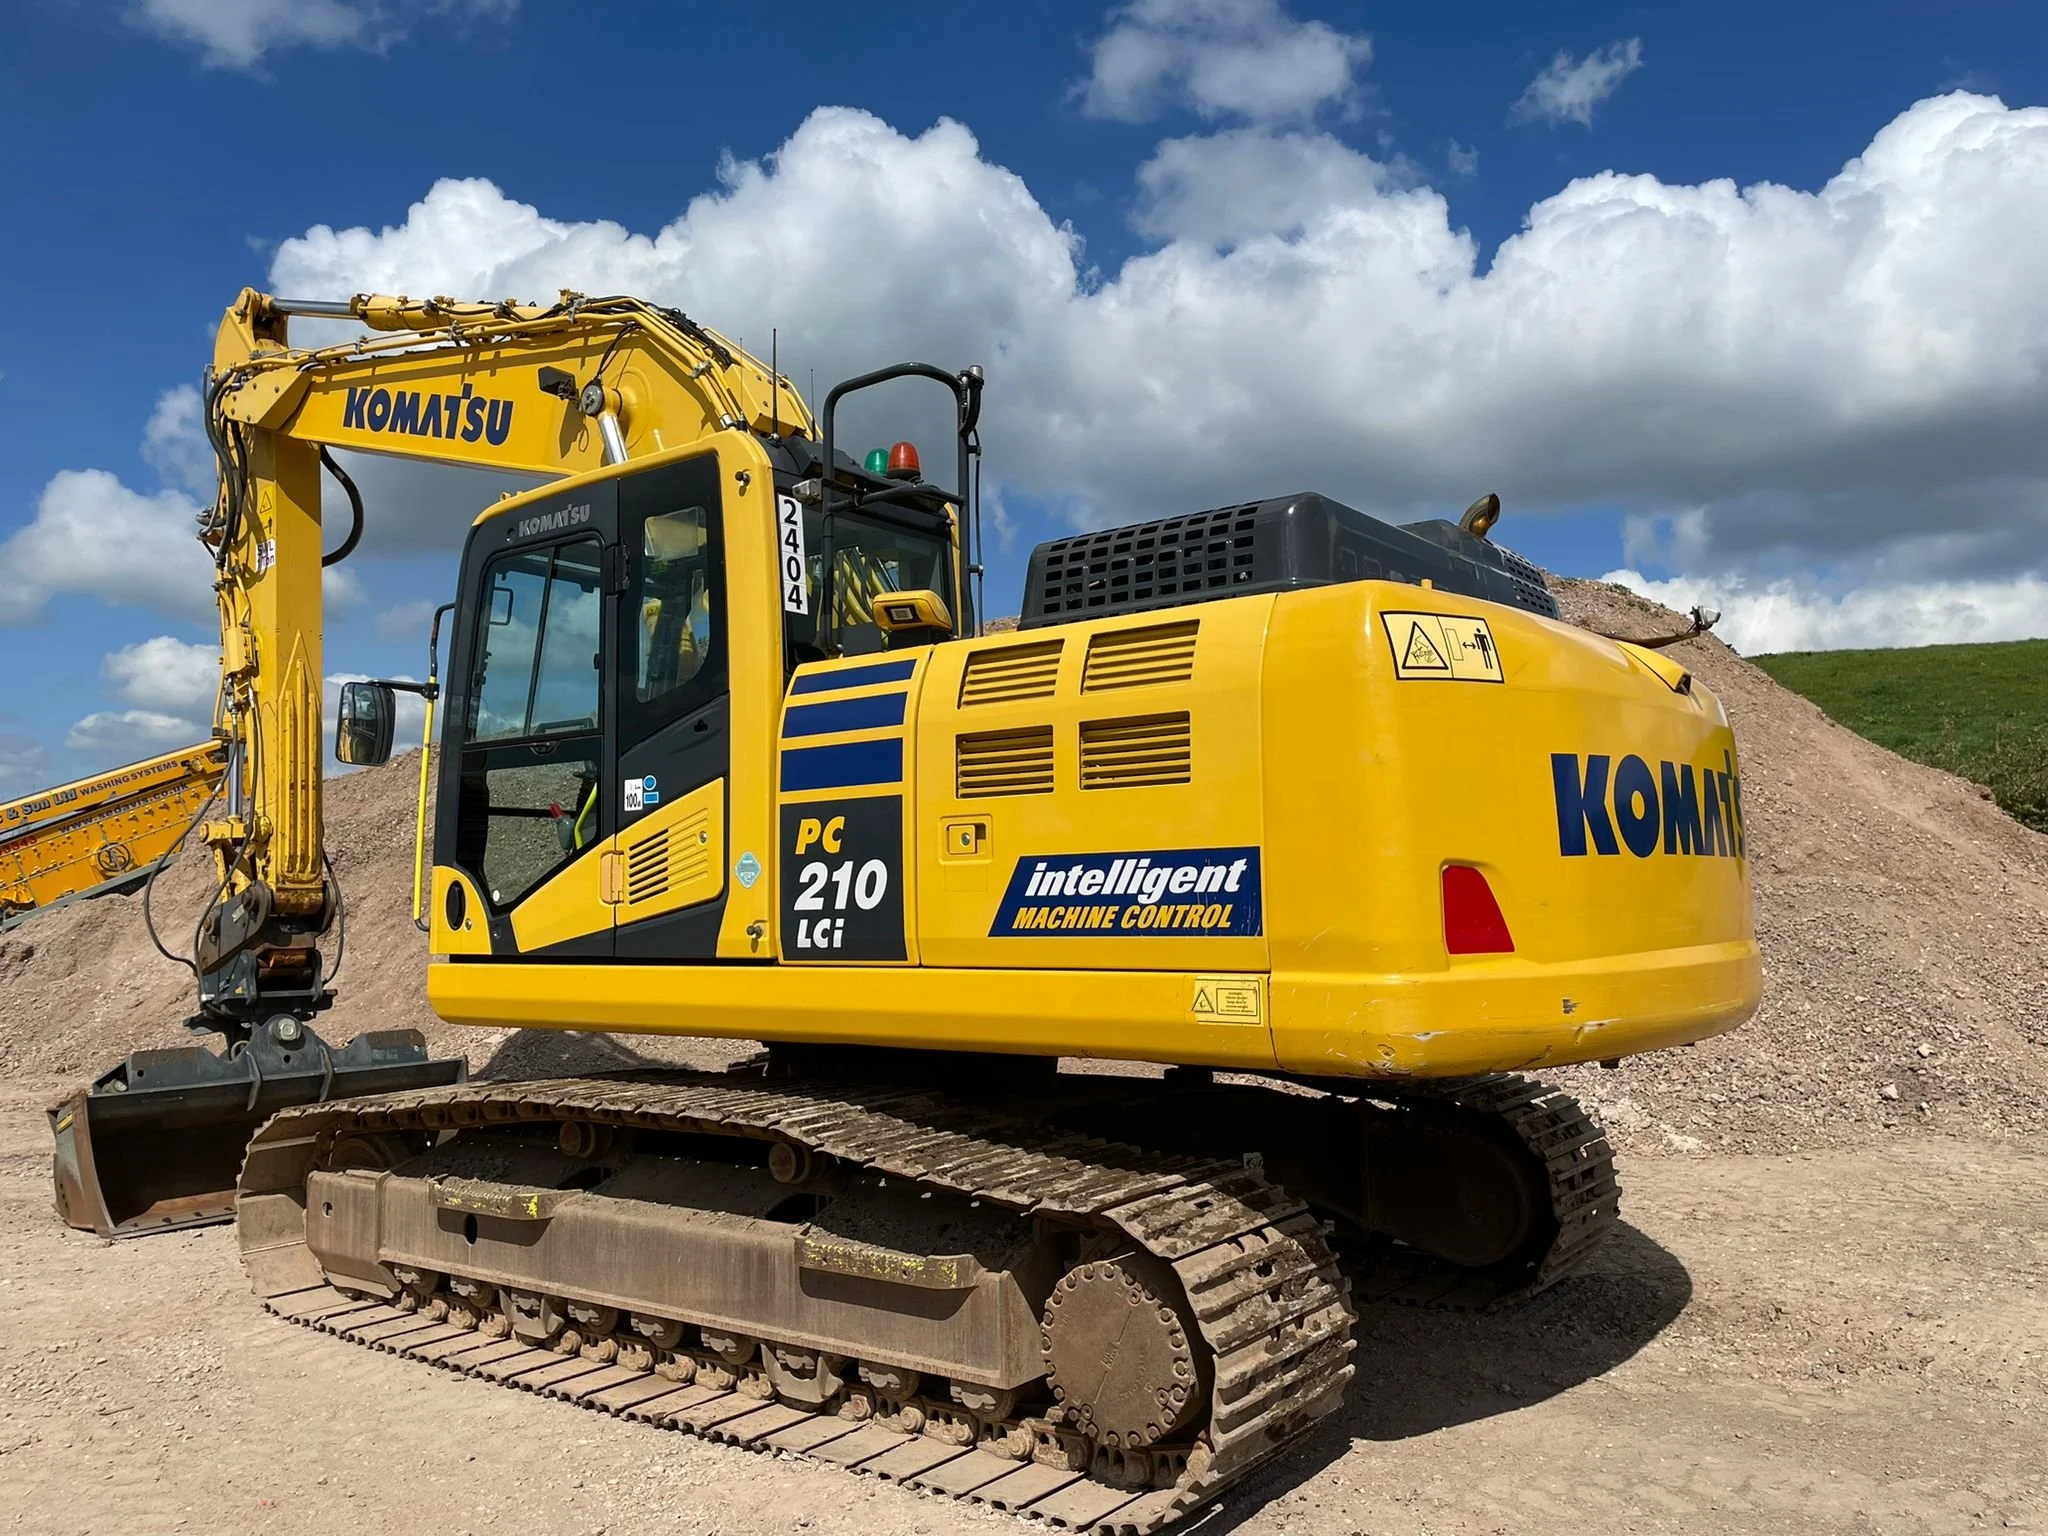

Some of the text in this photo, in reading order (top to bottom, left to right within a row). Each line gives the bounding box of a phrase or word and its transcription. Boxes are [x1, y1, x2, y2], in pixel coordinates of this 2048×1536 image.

[343, 383, 514, 446] KOMATSU
[518, 503, 591, 537] KOMATSU
[783, 498, 803, 610] 2404
[6, 807, 20, 820] &
[21, 799, 51, 815] Son
[52, 788, 78, 805] Ltd
[80, 775, 130, 796] WASHING
[130, 760, 178, 780] SYSTEMS
[795, 815, 846, 855] PC
[793, 858, 888, 911] 210
[1024, 857, 1248, 905] intelligent
[797, 918, 845, 948] LCi
[1012, 903, 1233, 929] MACHINE CONTROL
